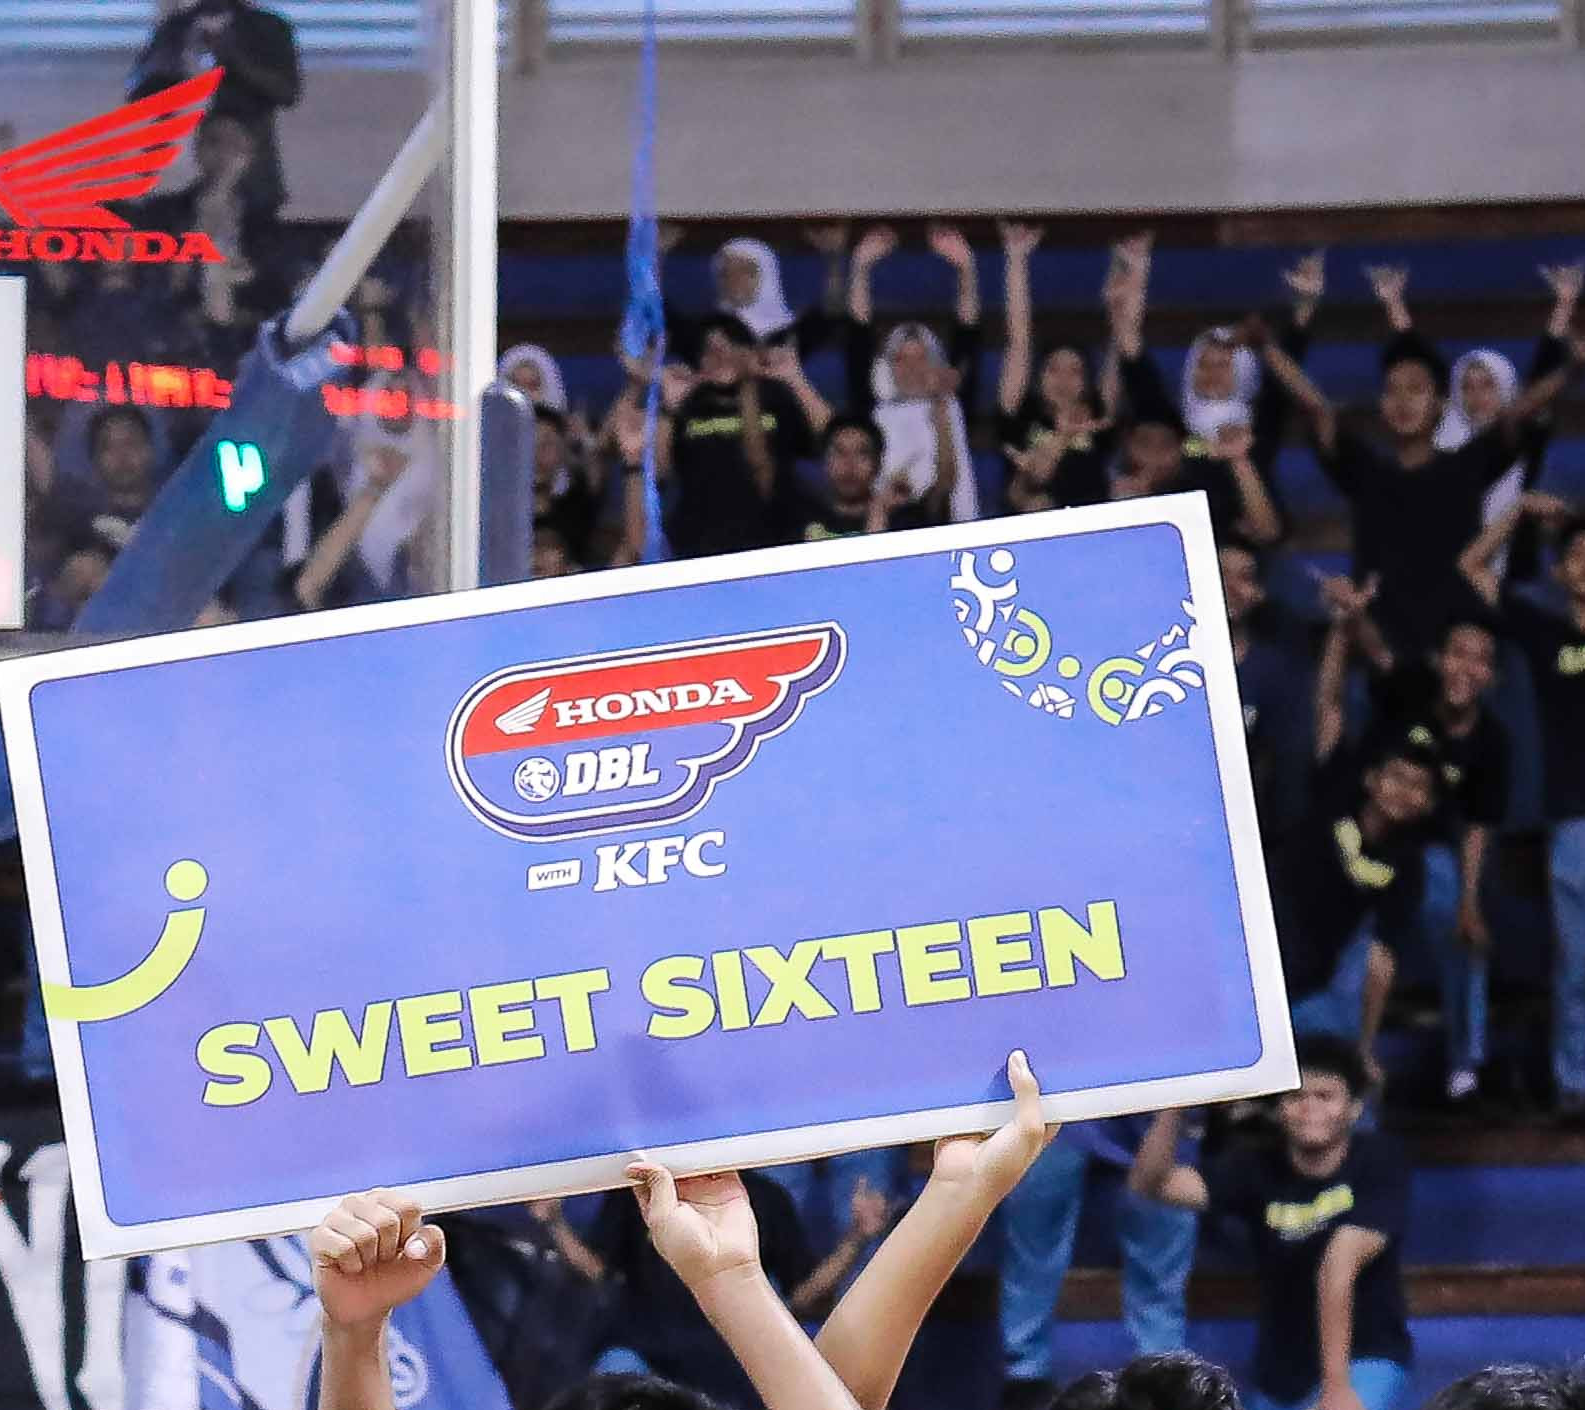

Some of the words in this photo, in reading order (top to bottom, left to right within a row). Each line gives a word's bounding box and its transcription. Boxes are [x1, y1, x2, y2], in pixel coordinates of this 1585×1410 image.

[550, 677, 753, 729] HONDA
[561, 743, 660, 797] DBL
[535, 866, 574, 884] WITH
[593, 830, 727, 893] KFC
[194, 966, 612, 1108] SWEET
[638, 898, 1126, 1045] SIXTEEN
